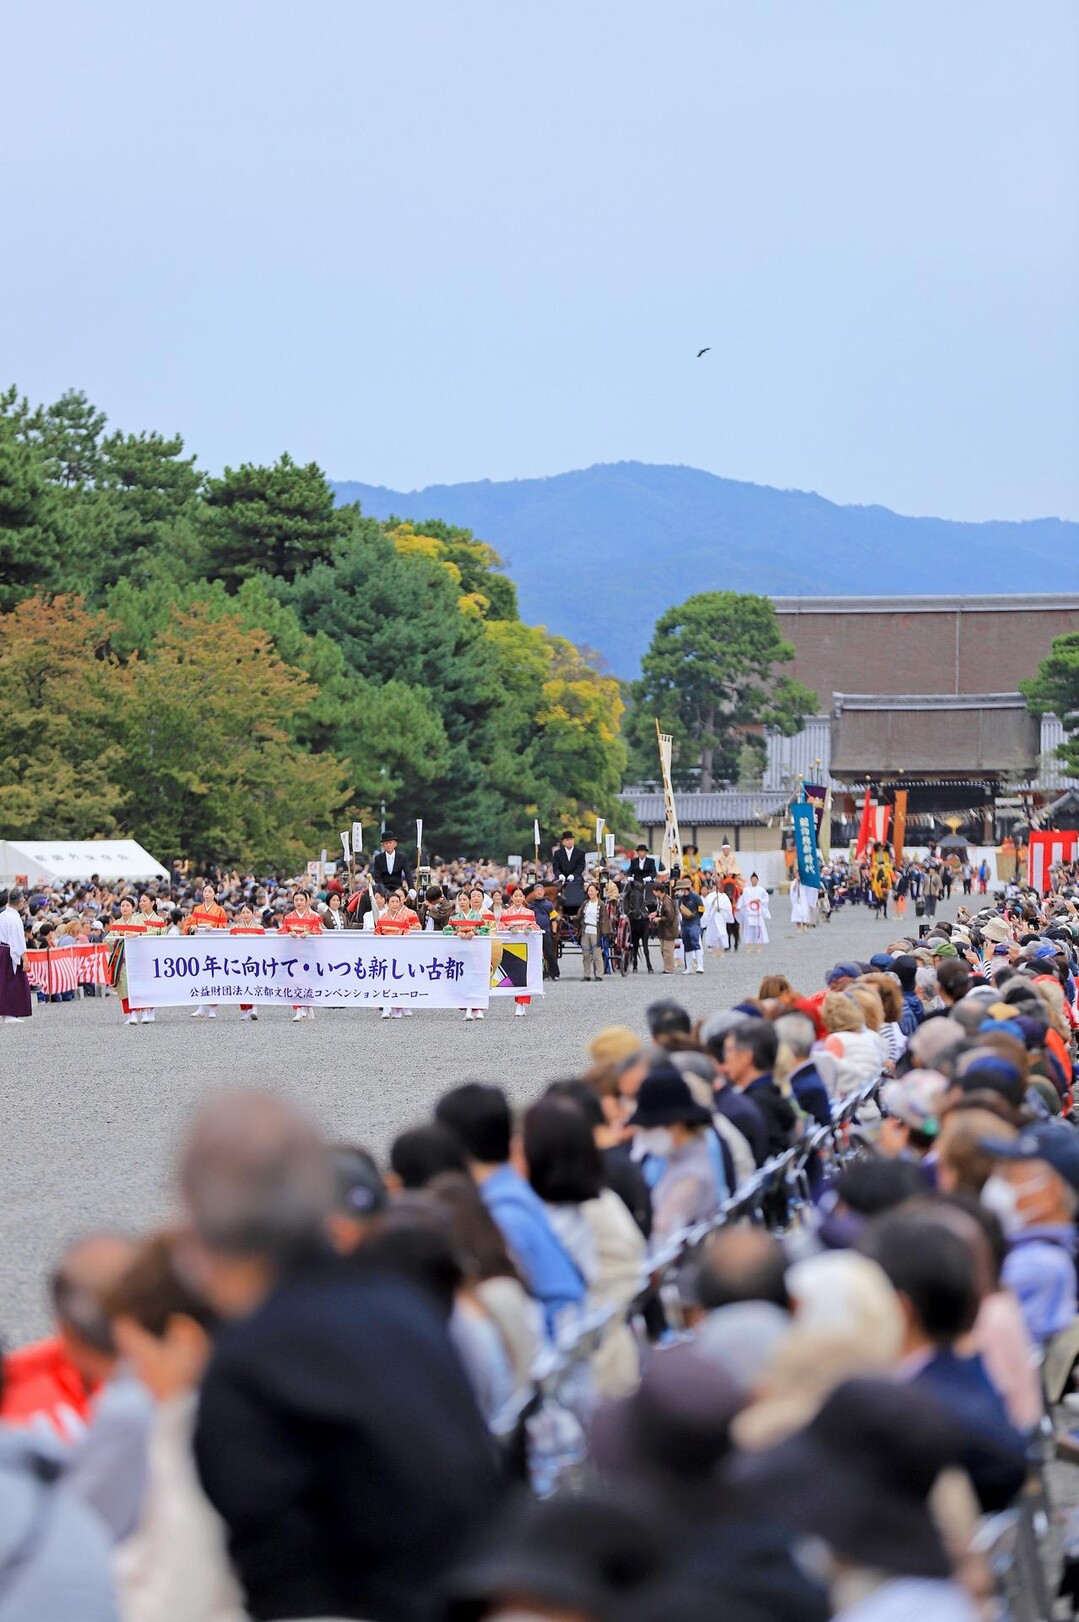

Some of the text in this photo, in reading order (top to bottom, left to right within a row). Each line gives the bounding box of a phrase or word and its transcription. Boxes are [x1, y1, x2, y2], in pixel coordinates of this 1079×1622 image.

[152, 955, 464, 982] 1300年に向けて・いつも新しい古都
[189, 985, 429, 999] 公益財団法人京都文化交流コンベンションビューロー
